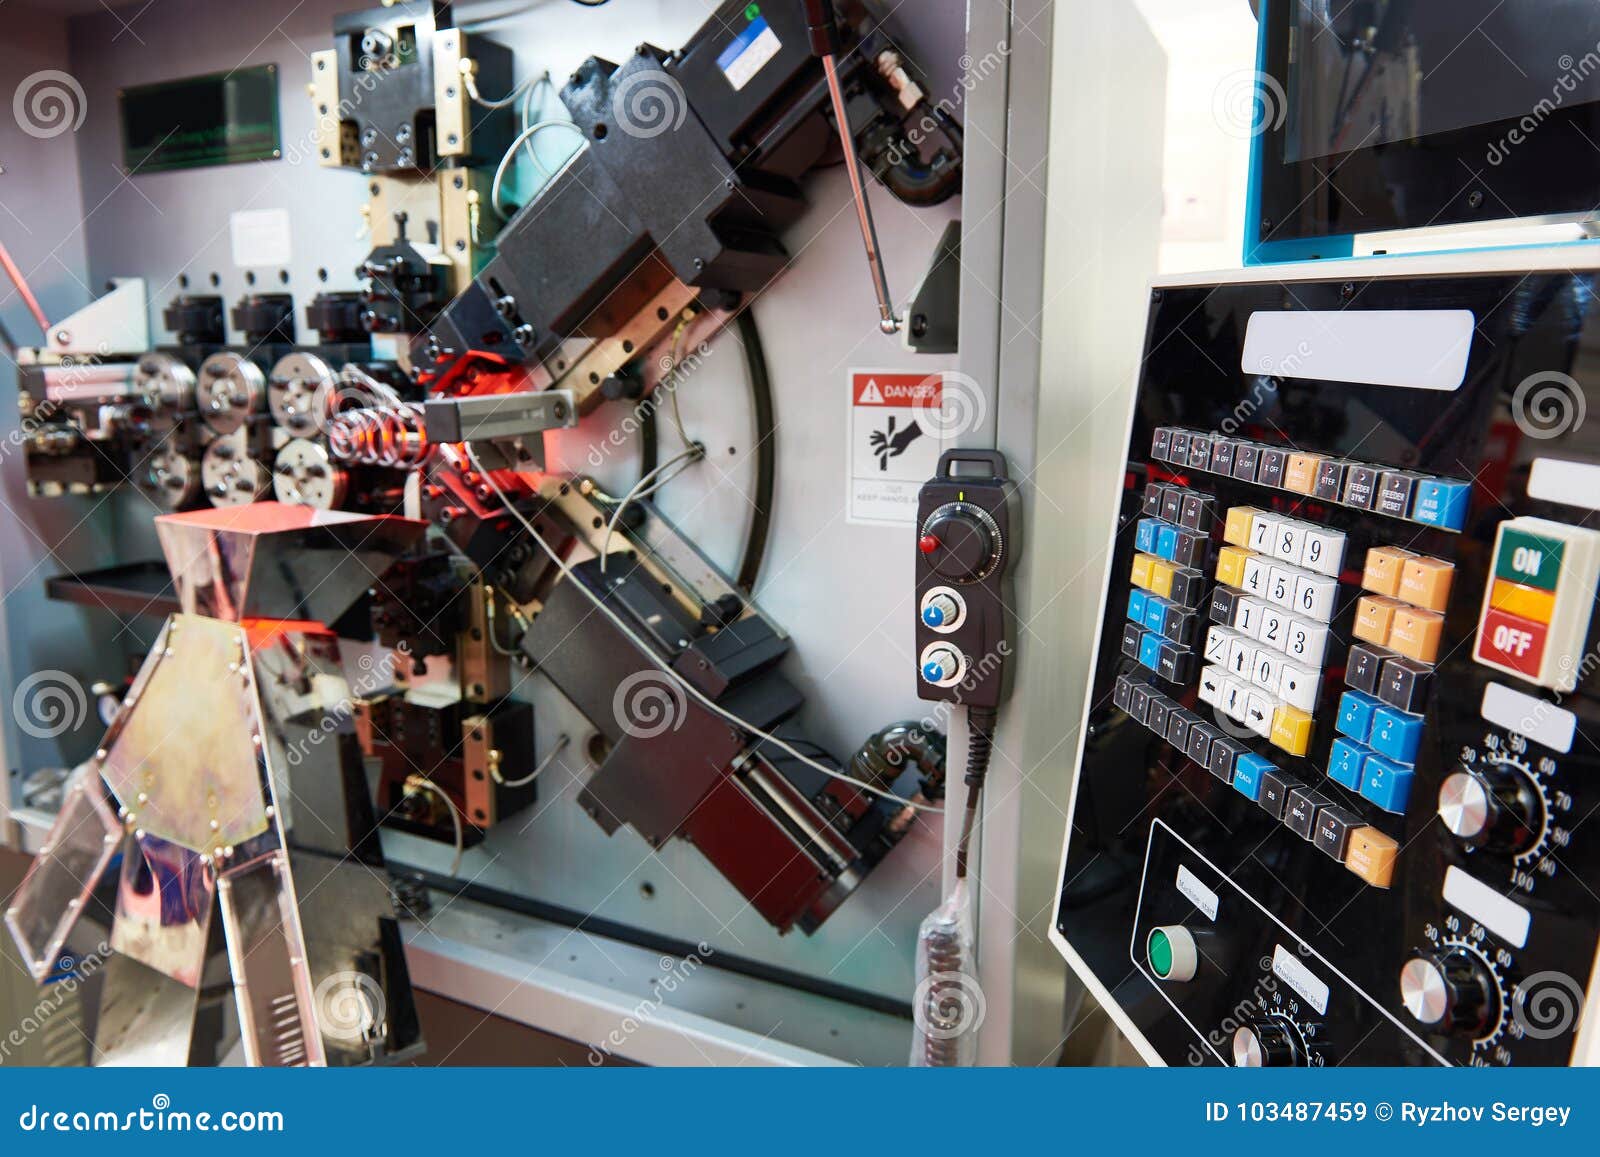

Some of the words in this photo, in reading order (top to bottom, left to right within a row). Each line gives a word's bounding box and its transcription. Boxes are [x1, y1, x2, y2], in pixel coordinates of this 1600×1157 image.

[884, 385, 936, 398] DANGER
[1270, 465, 1280, 473] OFF
[1321, 477, 1336, 486] STEP
[1350, 482, 1370, 494] FEEDER
[1350, 493, 1366, 503] SYNC
[1381, 489, 1405, 500] FEEDER
[1382, 500, 1402, 511] RESET
[1257, 523, 1267, 544] 7
[1281, 531, 1293, 554] 8
[1310, 540, 1321, 562] 9
[1512, 546, 1543, 577] ON
[1249, 569, 1259, 589] 4
[1275, 578, 1286, 599] 5
[1303, 587, 1314, 610] 6
[1213, 601, 1228, 613] CLEAR
[1242, 609, 1250, 629] 1
[1267, 618, 1278, 641] 2
[1294, 631, 1305, 653] 3
[1493, 625, 1533, 658] OFF
[1260, 661, 1270, 683] 0
[1392, 681, 1401, 691] V2
[1484, 733, 1499, 751] 40
[1510, 736, 1527, 754] 50
[1461, 746, 1476, 763] 30
[1539, 757, 1556, 776] 60
[1236, 769, 1252, 785] TEACH
[1555, 790, 1572, 811] 70
[1321, 826, 1337, 842] TEST
[1552, 827, 1569, 847] 80
[1538, 857, 1556, 877] 90
[1510, 868, 1534, 892] 100
[1424, 923, 1438, 941] 30
[1446, 915, 1459, 932] 40
[1471, 922, 1485, 941] 50
[1497, 949, 1512, 968] 60
[1272, 991, 1281, 1004] 40
[1289, 999, 1298, 1014] 50
[1306, 1023, 1315, 1037] 60
[1314, 1052, 1324, 1067] 70
[1496, 1046, 1511, 1065] 90
